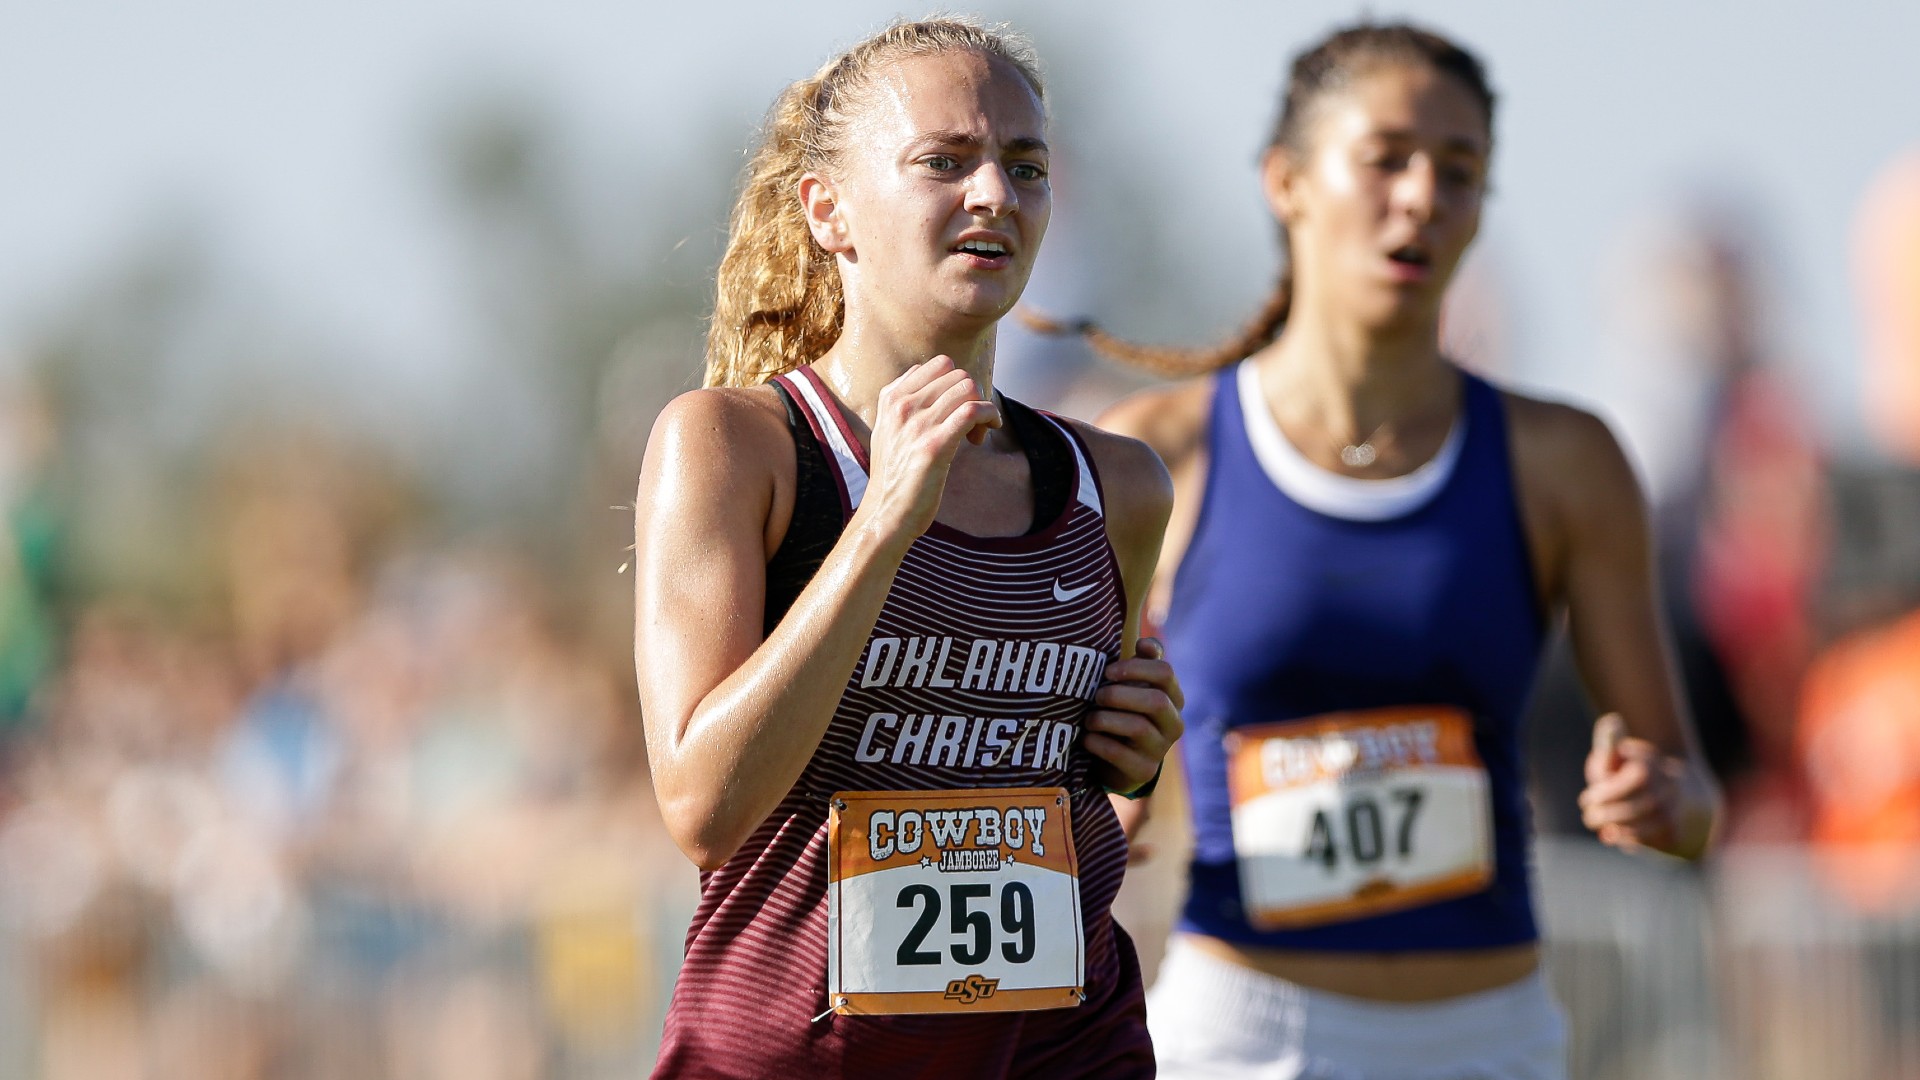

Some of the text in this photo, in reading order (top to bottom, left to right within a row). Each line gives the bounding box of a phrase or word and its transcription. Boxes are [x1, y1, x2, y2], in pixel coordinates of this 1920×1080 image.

[854, 712, 1080, 772] CHRISTIA
[869, 807, 1045, 861] COWBOY
[1304, 786, 1424, 874] 407
[938, 849, 1000, 872] JAMBOREE
[896, 882, 1036, 966] 259
[944, 974, 1000, 1004] OSU
